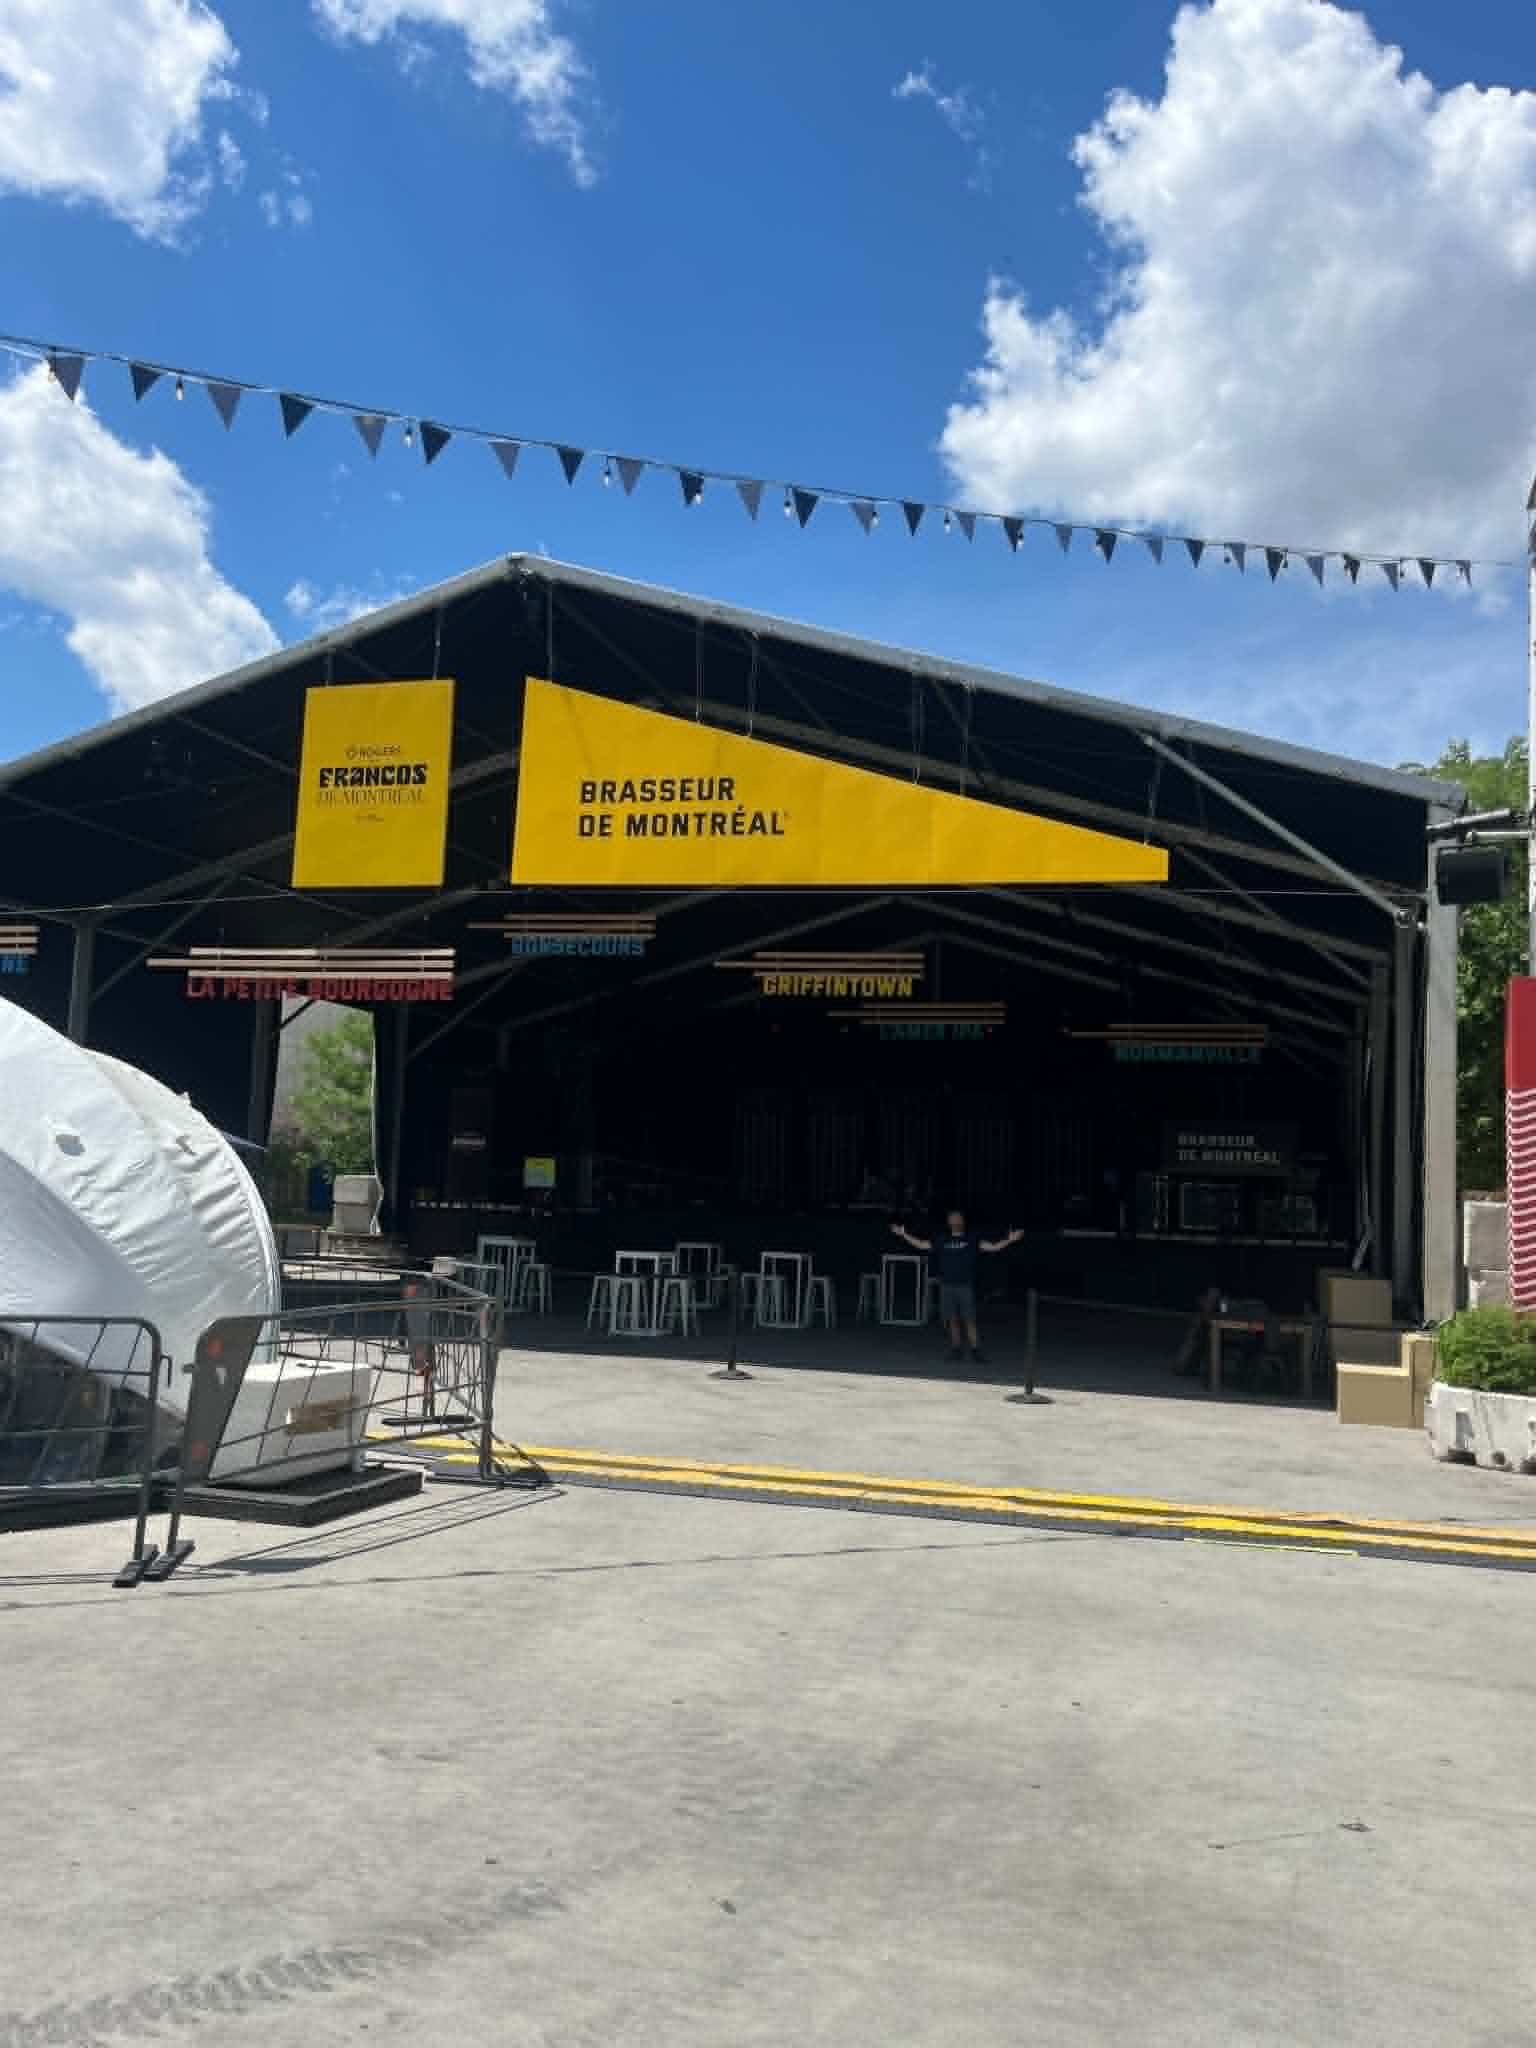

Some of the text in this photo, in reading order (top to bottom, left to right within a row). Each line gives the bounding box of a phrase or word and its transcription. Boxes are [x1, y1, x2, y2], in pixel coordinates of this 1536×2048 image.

[319, 763, 428, 788] FRANCOS
[580, 777, 736, 804] BRASSEUR
[579, 805, 785, 838] DE MONTRÉAL
[186, 976, 454, 1000] LA PETITE BOURGOGNE
[760, 975, 913, 998] GRIFFINTOWN
